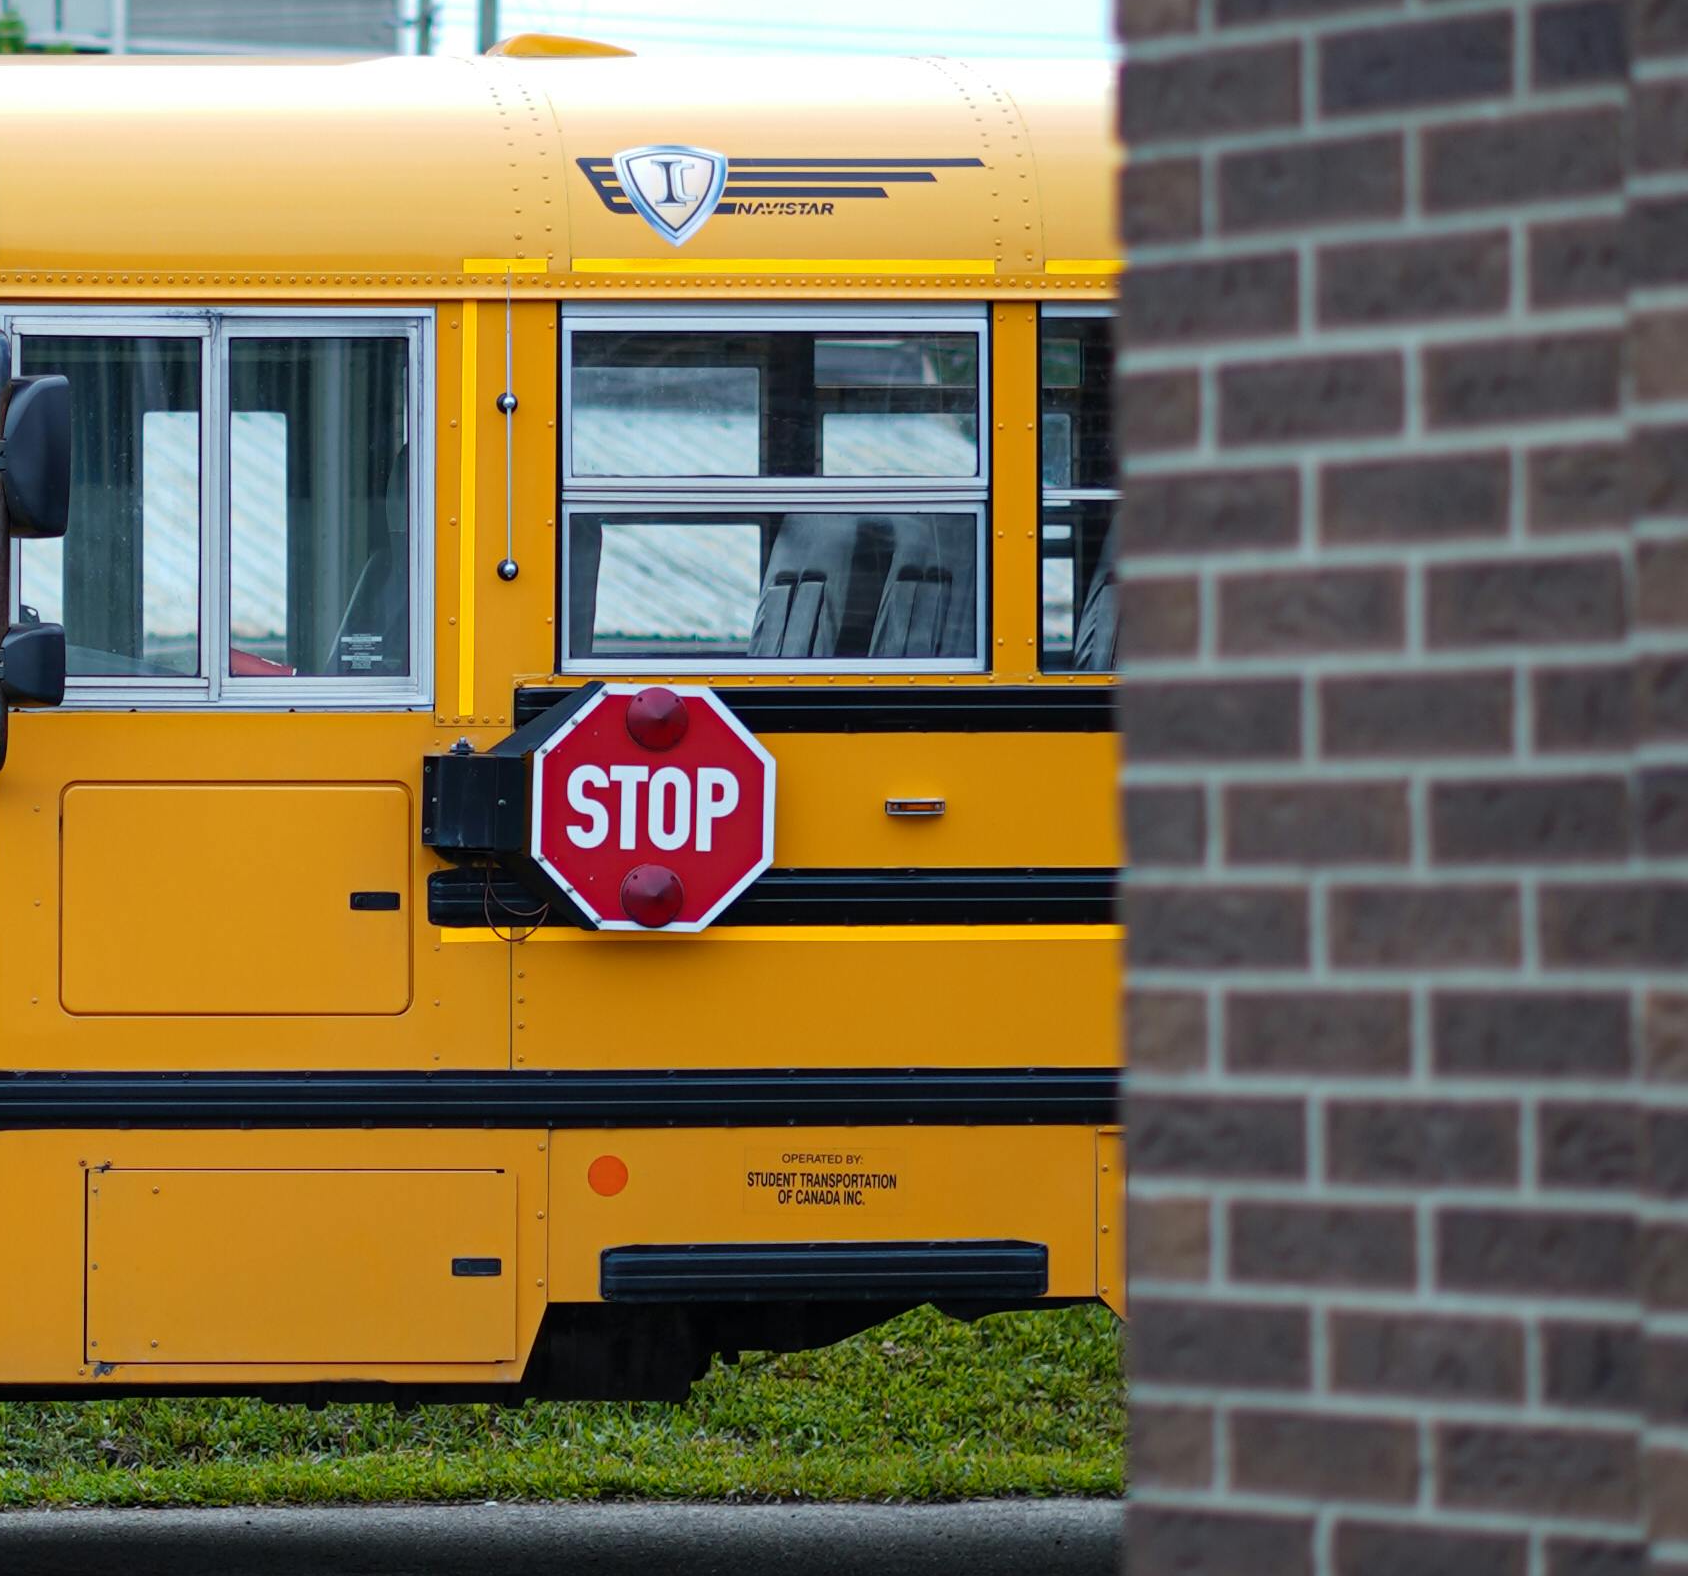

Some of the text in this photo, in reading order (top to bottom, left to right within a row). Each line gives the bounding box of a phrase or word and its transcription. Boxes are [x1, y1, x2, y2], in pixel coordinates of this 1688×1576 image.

[736, 202, 834, 215] NAVISTAR
[566, 764, 740, 852] STOP
[781, 1153, 864, 1165] OPERATED BY:
[747, 1172, 897, 1189] STUDENT TRANSPORTATION
[778, 1189, 865, 1206] OF CANADA INC.
